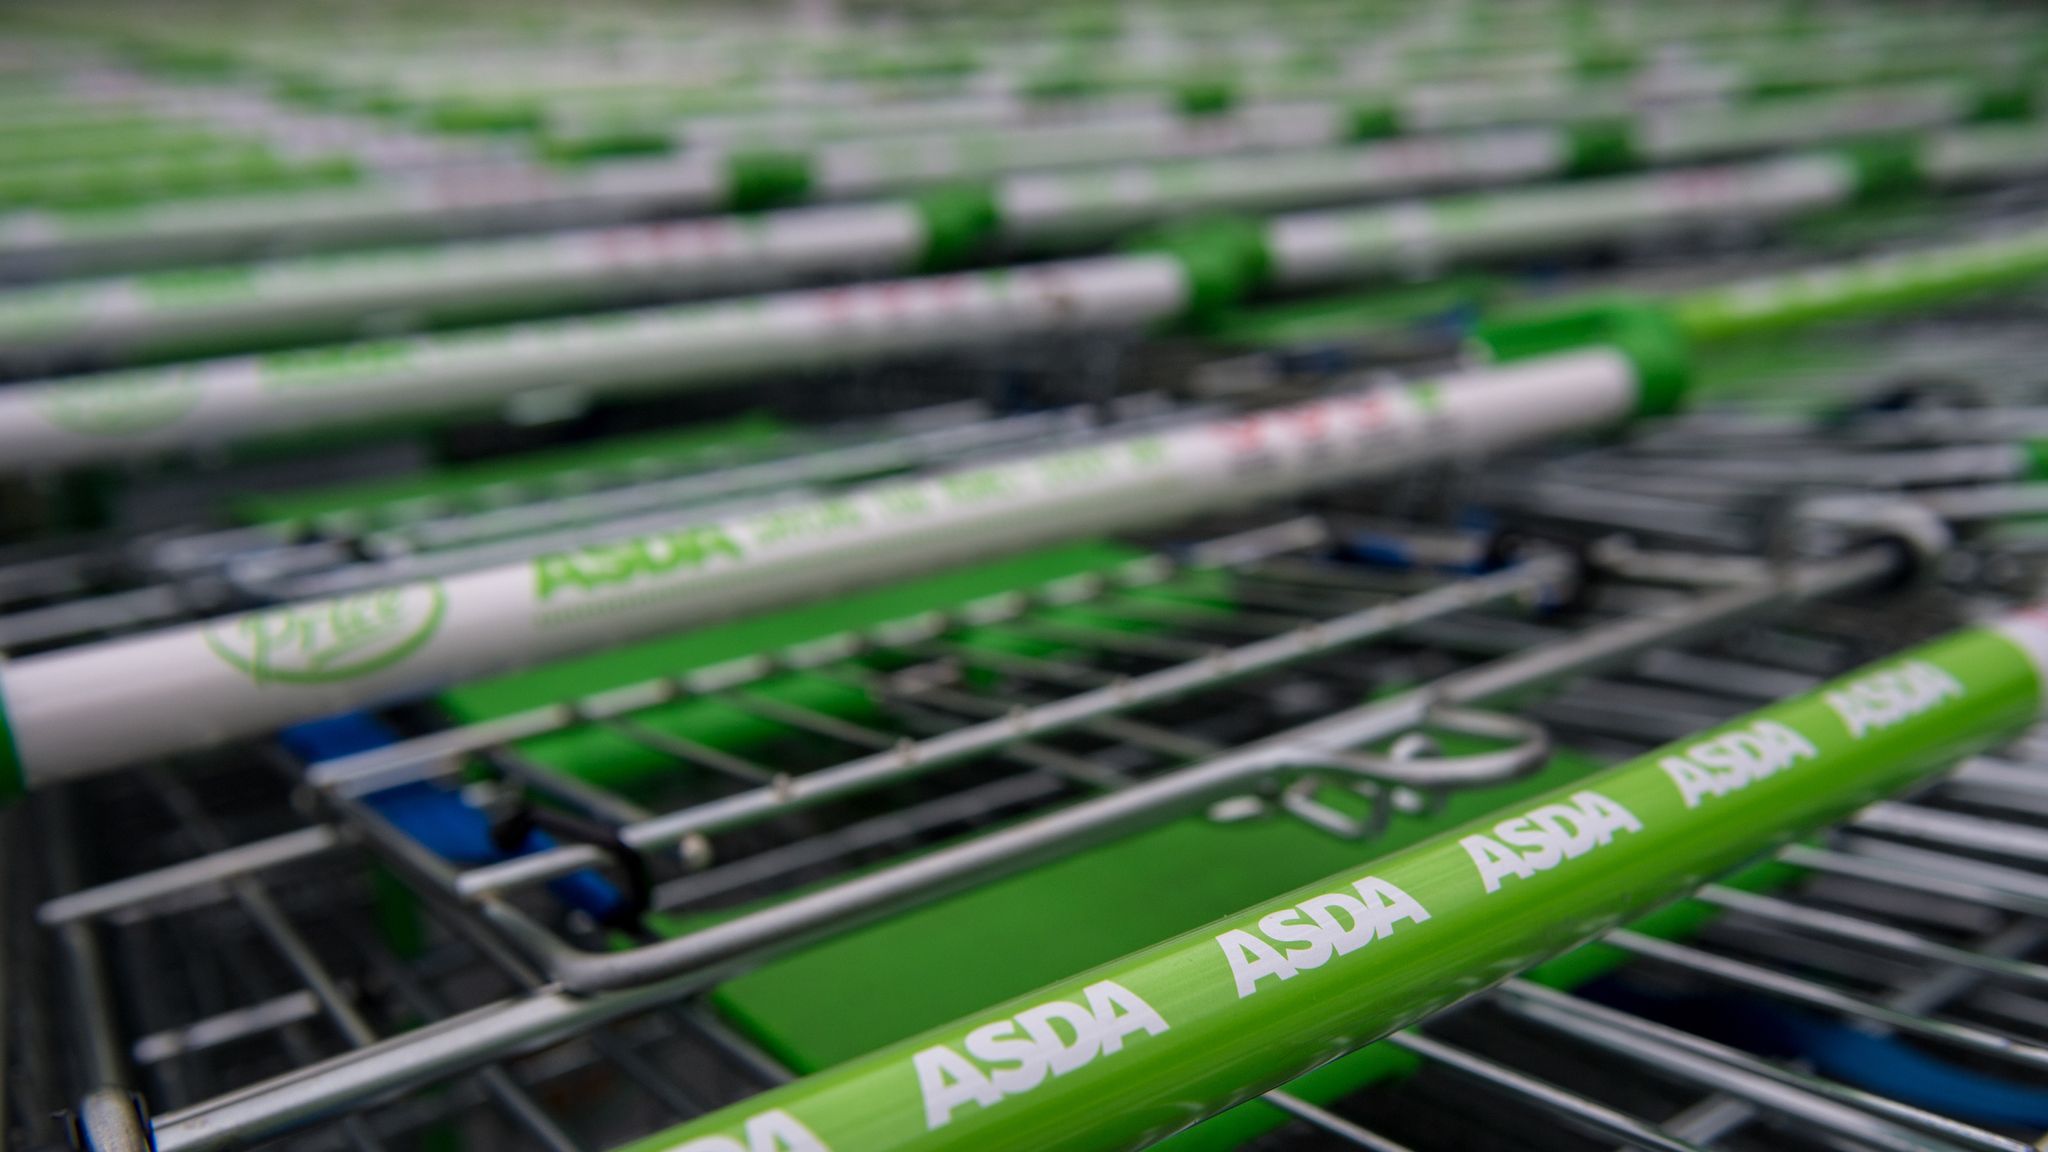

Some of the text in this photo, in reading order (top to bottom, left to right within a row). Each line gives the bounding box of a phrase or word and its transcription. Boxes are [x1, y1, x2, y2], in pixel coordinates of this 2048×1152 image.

[532, 520, 742, 599] ASDA
[1823, 660, 1965, 738] ASDA
[1658, 719, 1819, 808] ASDA
[1459, 790, 1644, 894] ASDA
[1215, 876, 1432, 999] ASDA
[912, 979, 1171, 1131] ASDA
